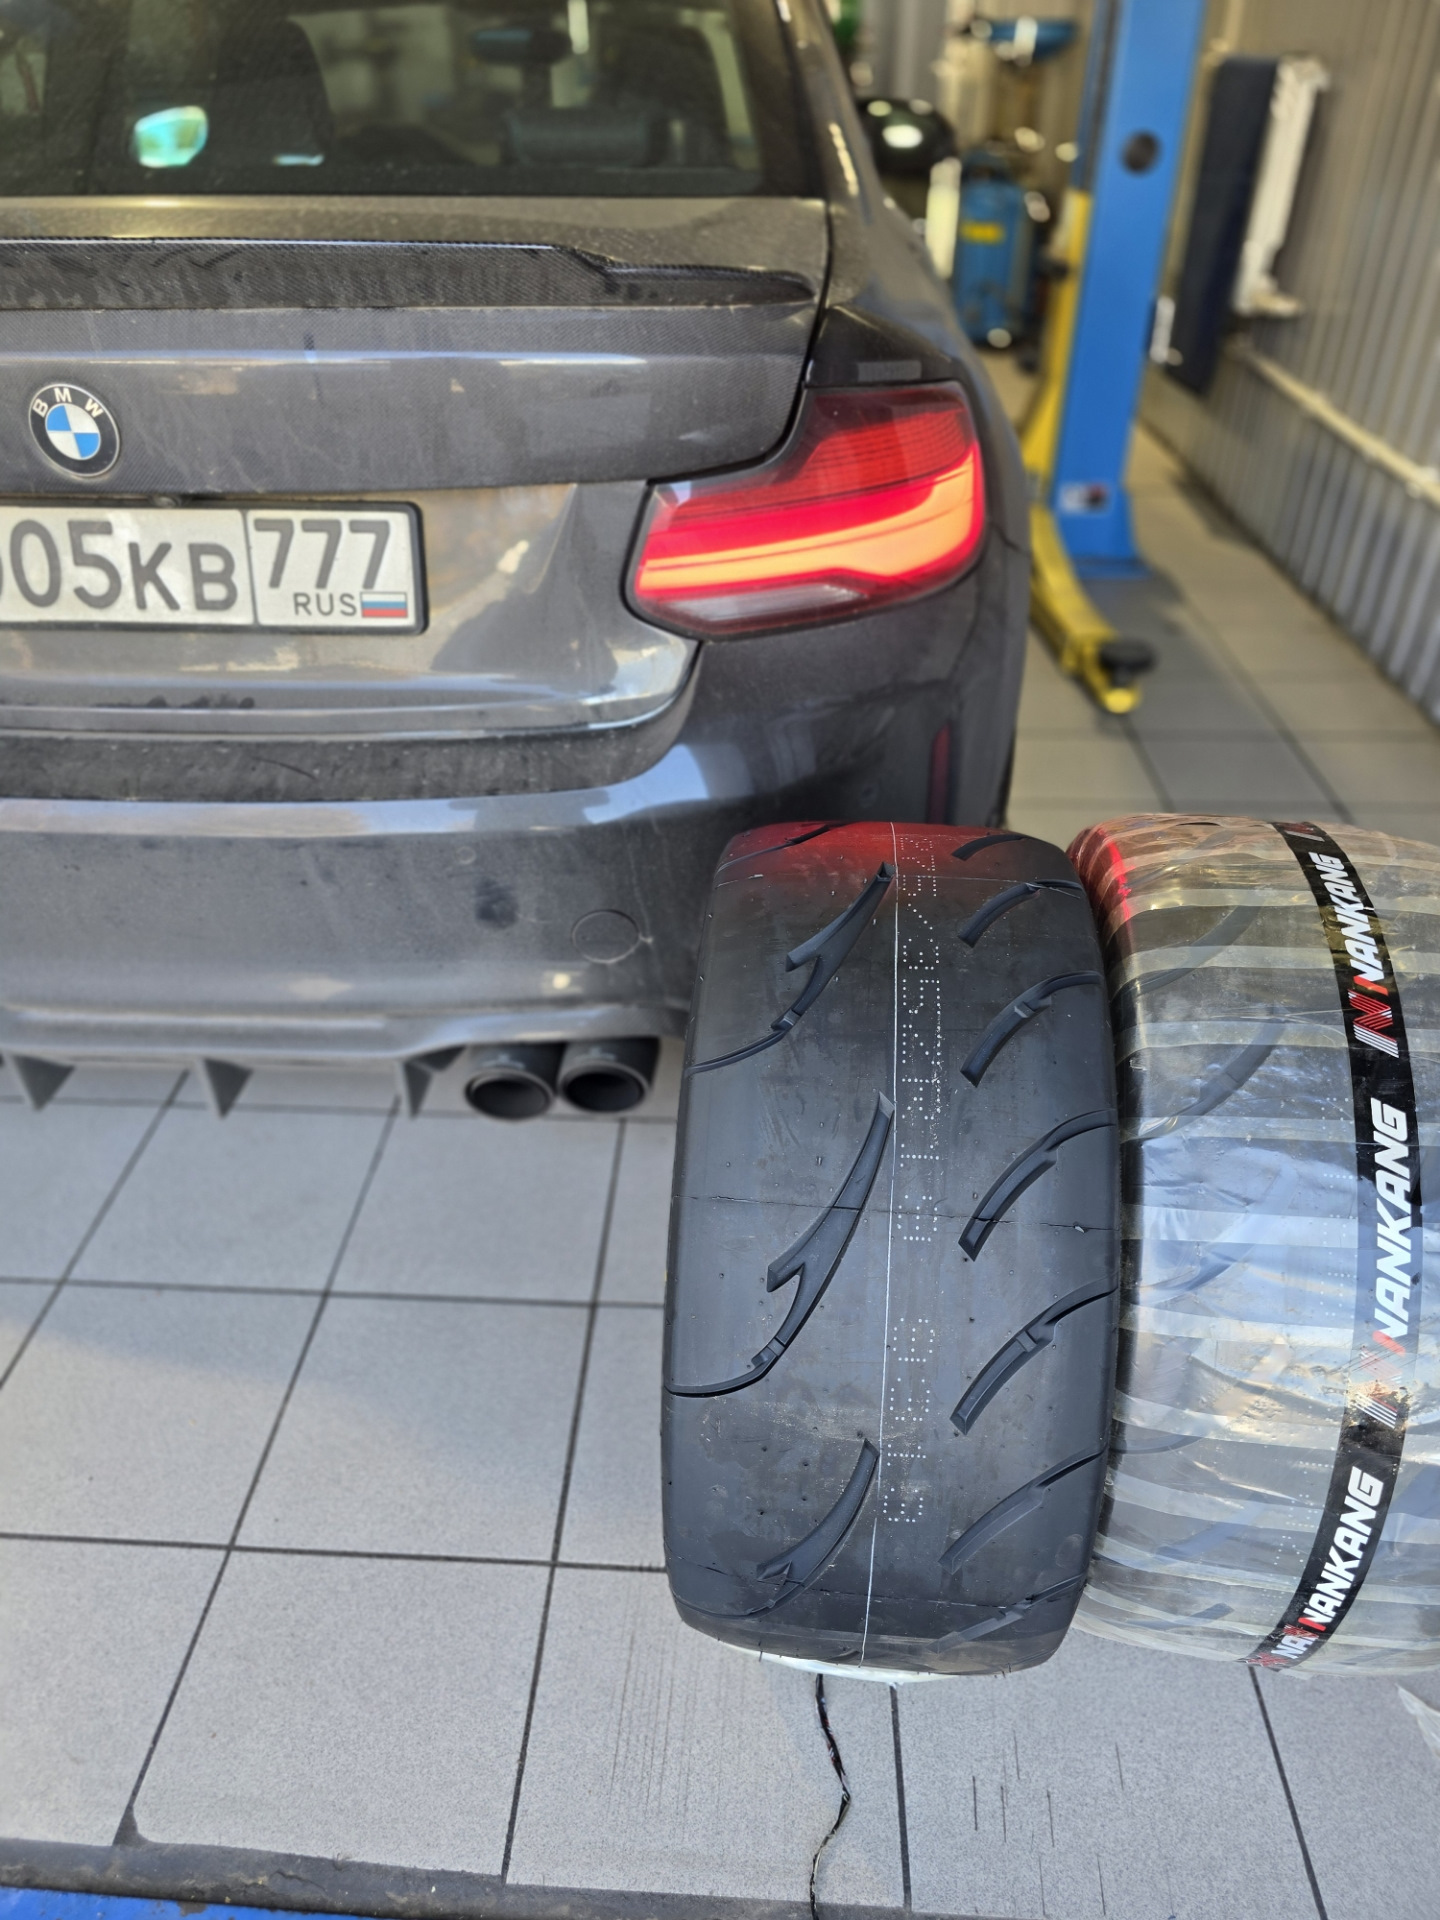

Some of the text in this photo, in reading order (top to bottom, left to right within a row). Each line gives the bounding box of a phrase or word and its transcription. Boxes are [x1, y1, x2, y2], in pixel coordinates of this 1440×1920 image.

[32, 387, 104, 418] BMW
[0, 518, 239, 612] 05KB
[253, 518, 391, 590] 777
[293, 592, 358, 616] RUS
[1308, 851, 1389, 996] NANKANG
[1370, 1096, 1412, 1356] NANKANG
[1298, 1465, 1385, 1632] NANKANG
